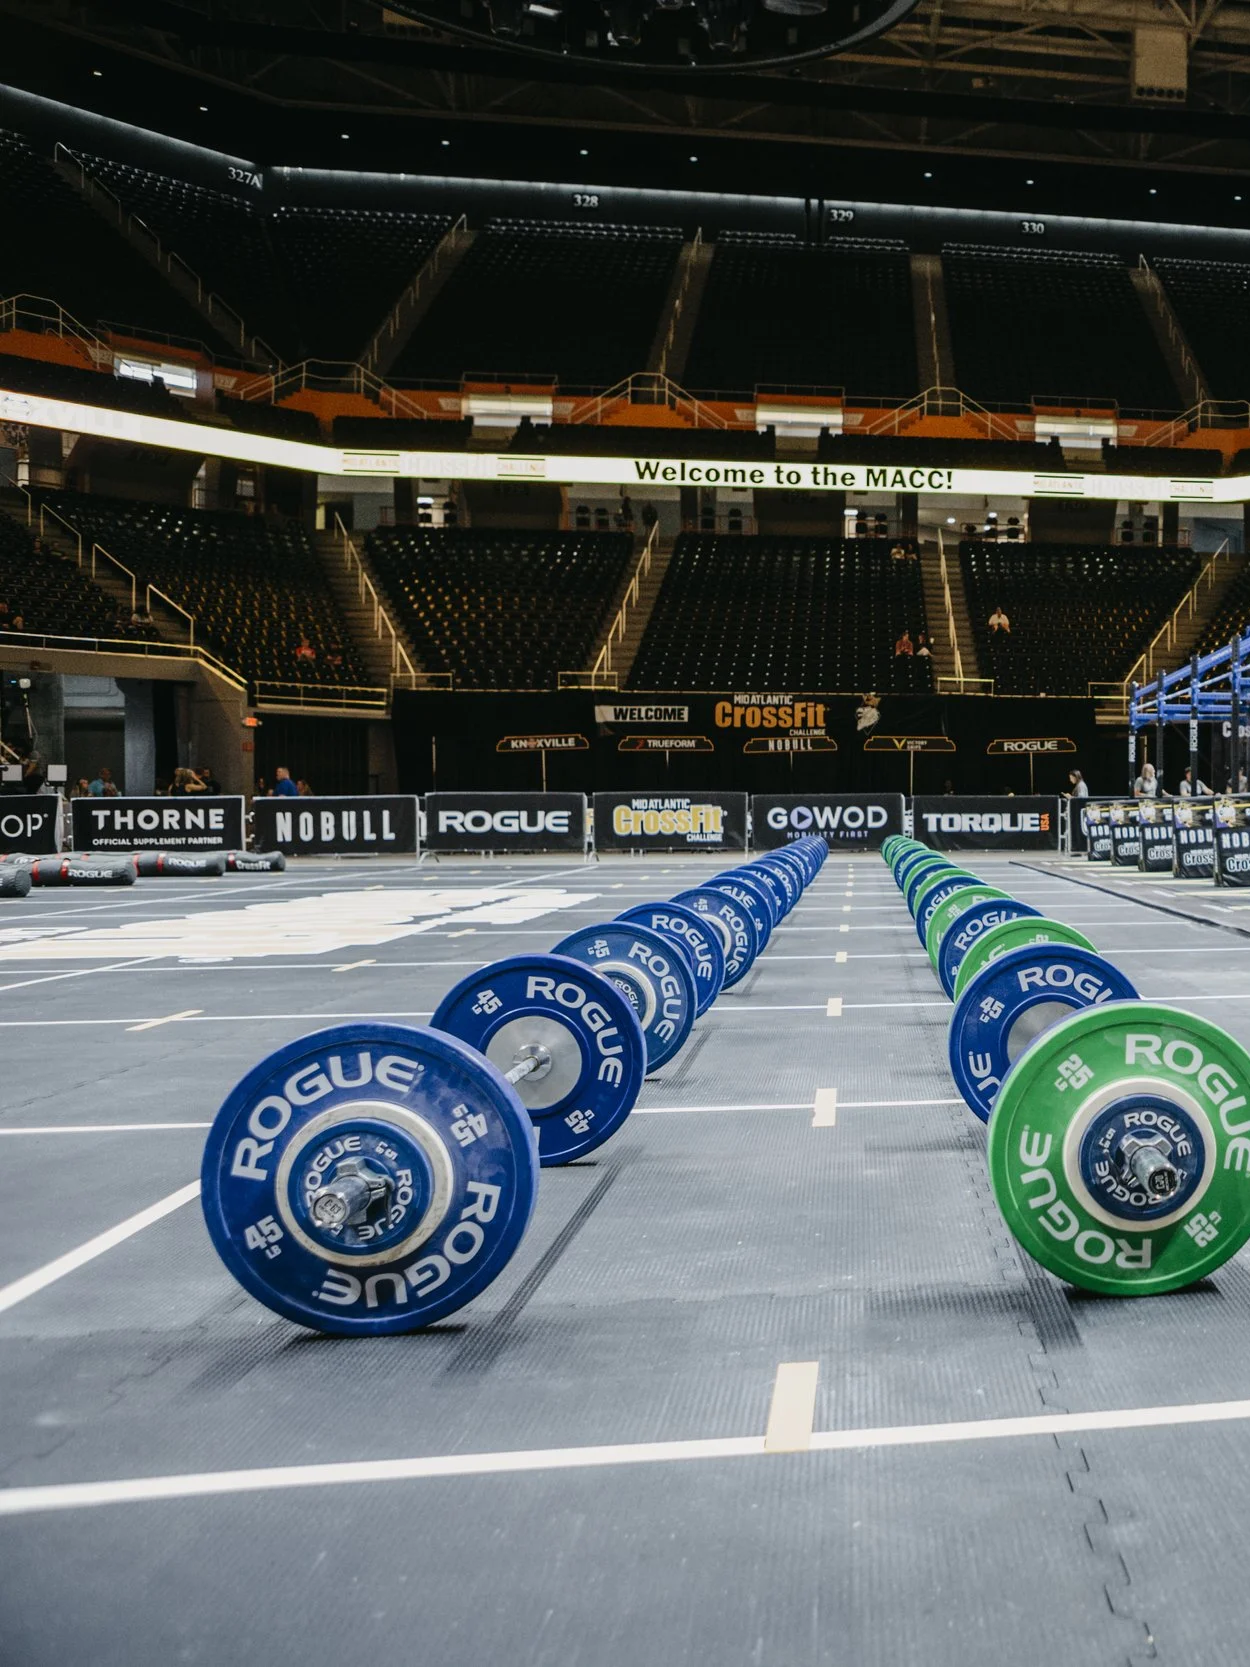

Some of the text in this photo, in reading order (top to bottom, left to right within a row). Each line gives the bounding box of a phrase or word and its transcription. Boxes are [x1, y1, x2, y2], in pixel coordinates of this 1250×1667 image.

[228, 167, 262, 189] 327A
[573, 194, 599, 207] 328
[830, 209, 854, 221] 329
[1022, 222, 1045, 234] 330
[634, 461, 953, 490] Welcome to the MACC!
[751, 695, 793, 705] ATLANTIC
[613, 707, 686, 721] WELCOME
[715, 700, 826, 728] CrossFit
[511, 738, 576, 749] KNOXVILLE
[646, 739, 696, 749] TRUEFORM
[768, 738, 813, 751] NOBULL
[1004, 740, 1058, 752] ROGUE
[650, 799, 691, 810] ATLANTIC
[92, 809, 225, 831] THORNE
[276, 810, 396, 843] NOBULL
[438, 810, 570, 834] ROGUE
[613, 805, 724, 836] CrossFit
[767, 805, 888, 829] GOWOD
[922, 813, 1040, 834] TORQUE
[92, 837, 223, 846] OFFICIAL SUPPLEMENT PARTNER
[840, 830, 868, 839] FIRST
[68, 869, 113, 879] ROGUE
[168, 857, 207, 868] ROGUE
[236, 859, 271, 870] CrossFit
[594, 940, 610, 958] 45
[652, 914, 713, 980] ROGUE
[719, 904, 748, 976] ROGUE
[477, 989, 503, 1014] 45
[628, 941, 682, 1043] ROGUE
[979, 996, 1005, 1019] 45
[526, 976, 624, 1086] ROGUE
[1057, 1053, 1095, 1090] 25
[230, 1052, 423, 1181] ROGUE
[564, 1109, 590, 1134] 45
[450, 1112, 489, 1147] 45
[1124, 1111, 1192, 1157] ROGUE
[1019, 1126, 1152, 1270] ROGUE
[244, 1216, 284, 1250] 45
[1183, 1211, 1220, 1248] 25
[265, 1246, 282, 1260] LB
[314, 1180, 502, 1309] ROGUE
